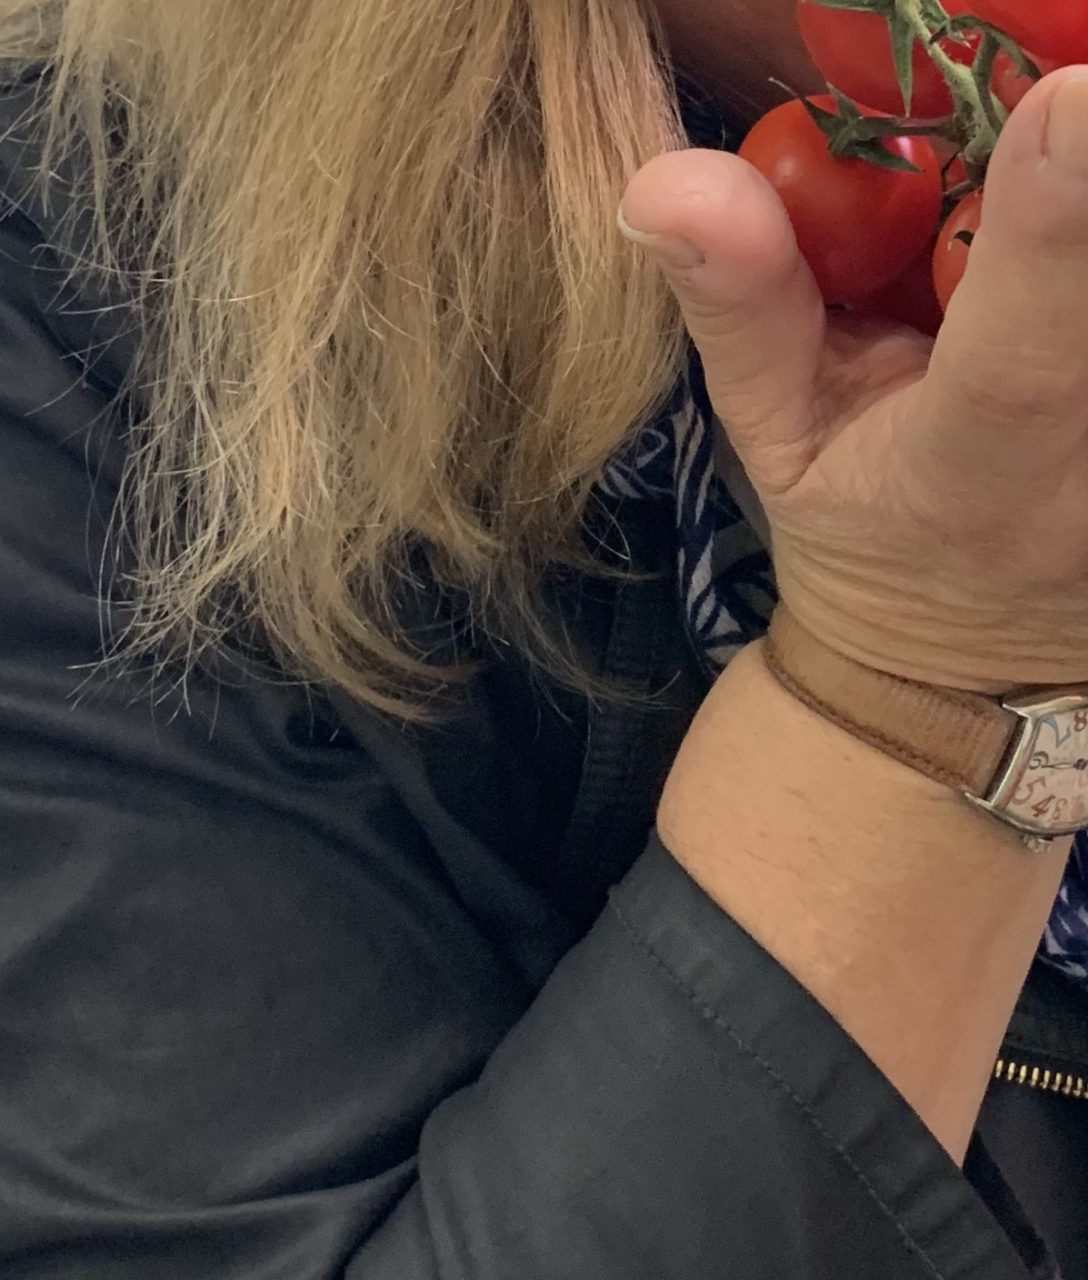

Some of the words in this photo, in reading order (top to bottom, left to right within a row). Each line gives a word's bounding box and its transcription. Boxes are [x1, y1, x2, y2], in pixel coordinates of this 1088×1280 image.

[1042, 713, 1072, 749] 7
[1074, 711, 1088, 732] 8
[1028, 750, 1049, 771] 6
[1012, 778, 1047, 806] 5
[1031, 794, 1055, 818] 4
